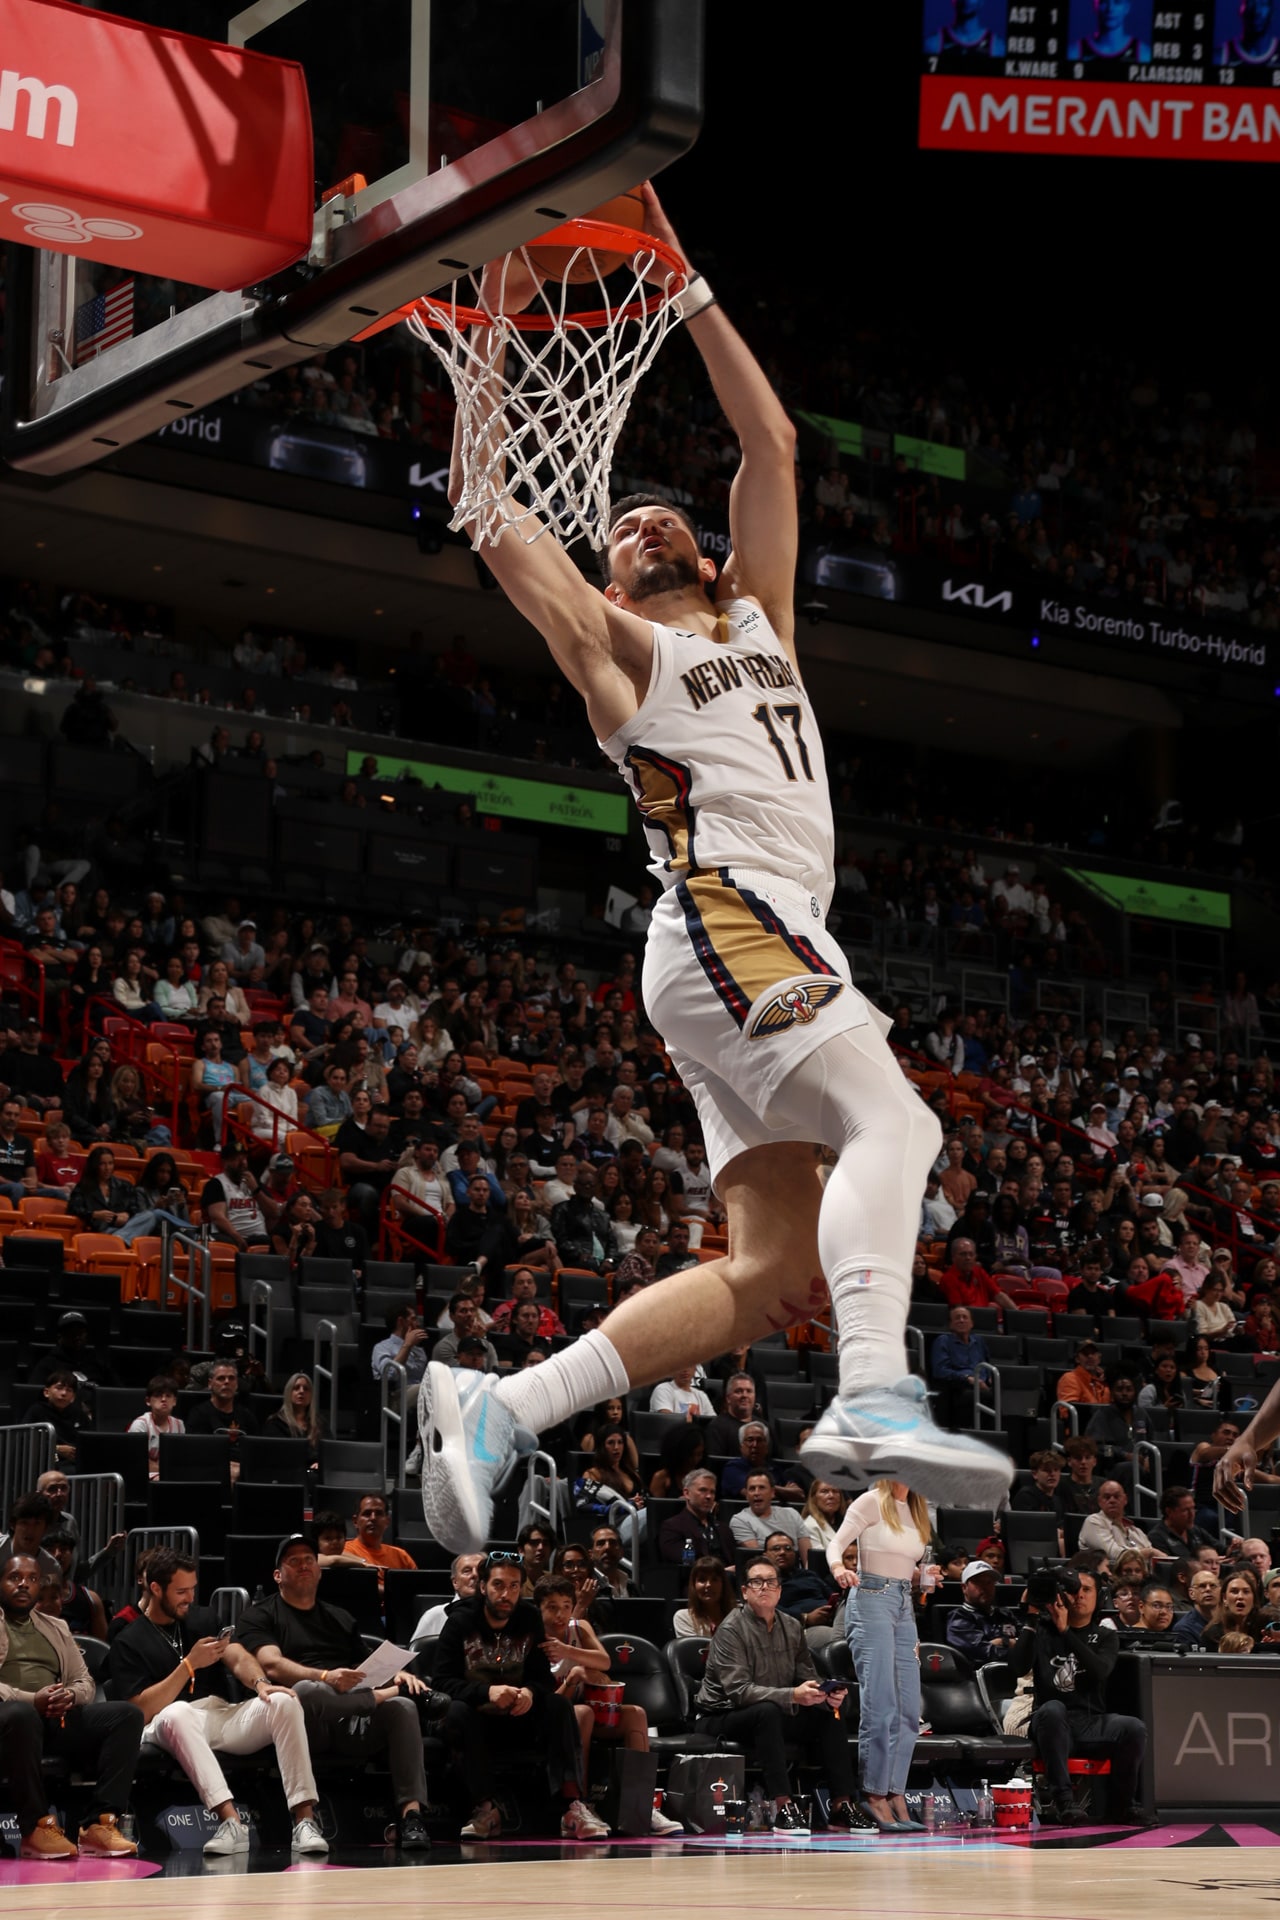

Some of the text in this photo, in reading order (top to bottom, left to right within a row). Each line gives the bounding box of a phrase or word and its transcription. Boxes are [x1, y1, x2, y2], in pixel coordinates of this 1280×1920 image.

[1008, 5, 1059, 25] AST 1
[1153, 11, 1205, 31] AST 5
[1007, 35, 1037, 55] REB
[1152, 41, 1204, 61] REB 3
[928, 55, 1059, 79] 7 K.WARE
[1128, 65, 1204, 84] P.LARSSON
[1218, 67, 1236, 86] 13
[940, 91, 1195, 141] AMERANT
[1040, 599, 1266, 666] Kia Sorento Turbo-Hybrid
[679, 656, 743, 711] NEW
[751, 702, 816, 783] 17
[229, 1198, 257, 1209] HEAT
[168, 1814, 193, 1826] ONE
